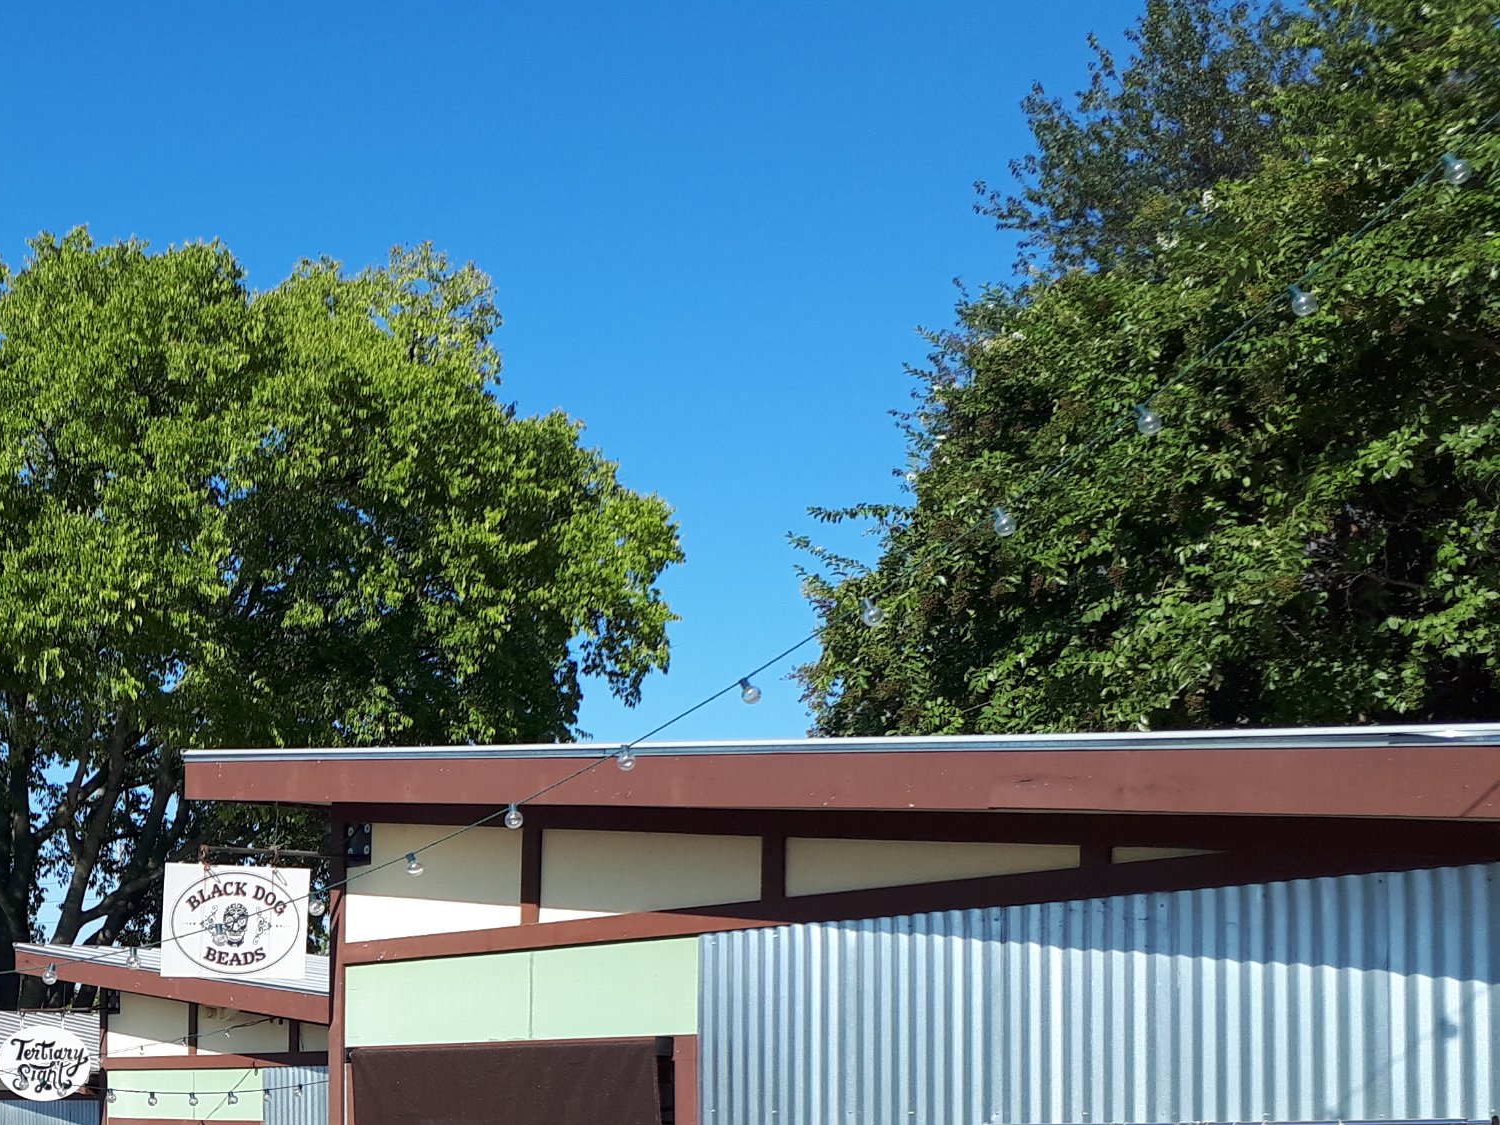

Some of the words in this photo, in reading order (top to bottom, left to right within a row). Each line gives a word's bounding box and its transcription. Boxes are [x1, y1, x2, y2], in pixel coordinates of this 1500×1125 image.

[185, 881, 248, 912] BLACK
[252, 885, 287, 917] DOG
[203, 946, 266, 966] BEADS
[10, 1038, 89, 1077] Tertiary
[12, 1061, 73, 1094] Sight
